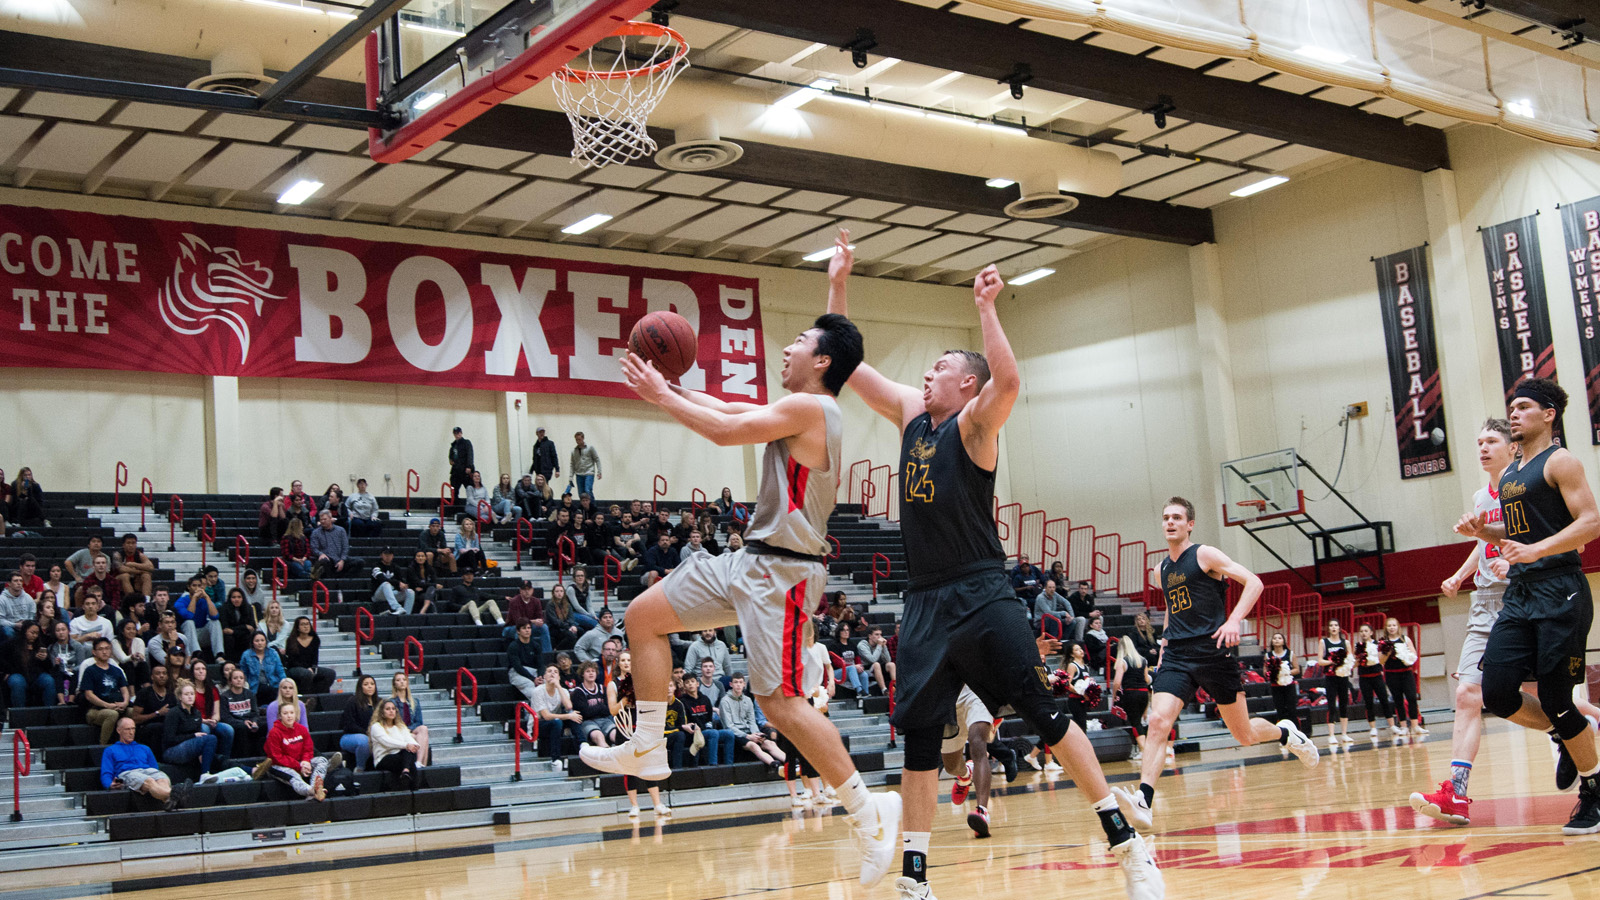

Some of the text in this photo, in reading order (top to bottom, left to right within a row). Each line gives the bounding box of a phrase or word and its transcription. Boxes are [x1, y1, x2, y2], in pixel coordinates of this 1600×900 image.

[0, 231, 141, 284] COME
[12, 287, 110, 335] THE
[1492, 268, 1511, 331] MEN'S
[1504, 231, 1535, 380] BASKETB
[1570, 247, 1595, 340] WOMEN'S
[718, 284, 758, 399] DEN
[1395, 262, 1430, 442] BASEBALL
[905, 461, 935, 503] 14
[1403, 457, 1447, 477] BOXERS
[1504, 500, 1530, 536] 11
[1168, 585, 1192, 614] 33
